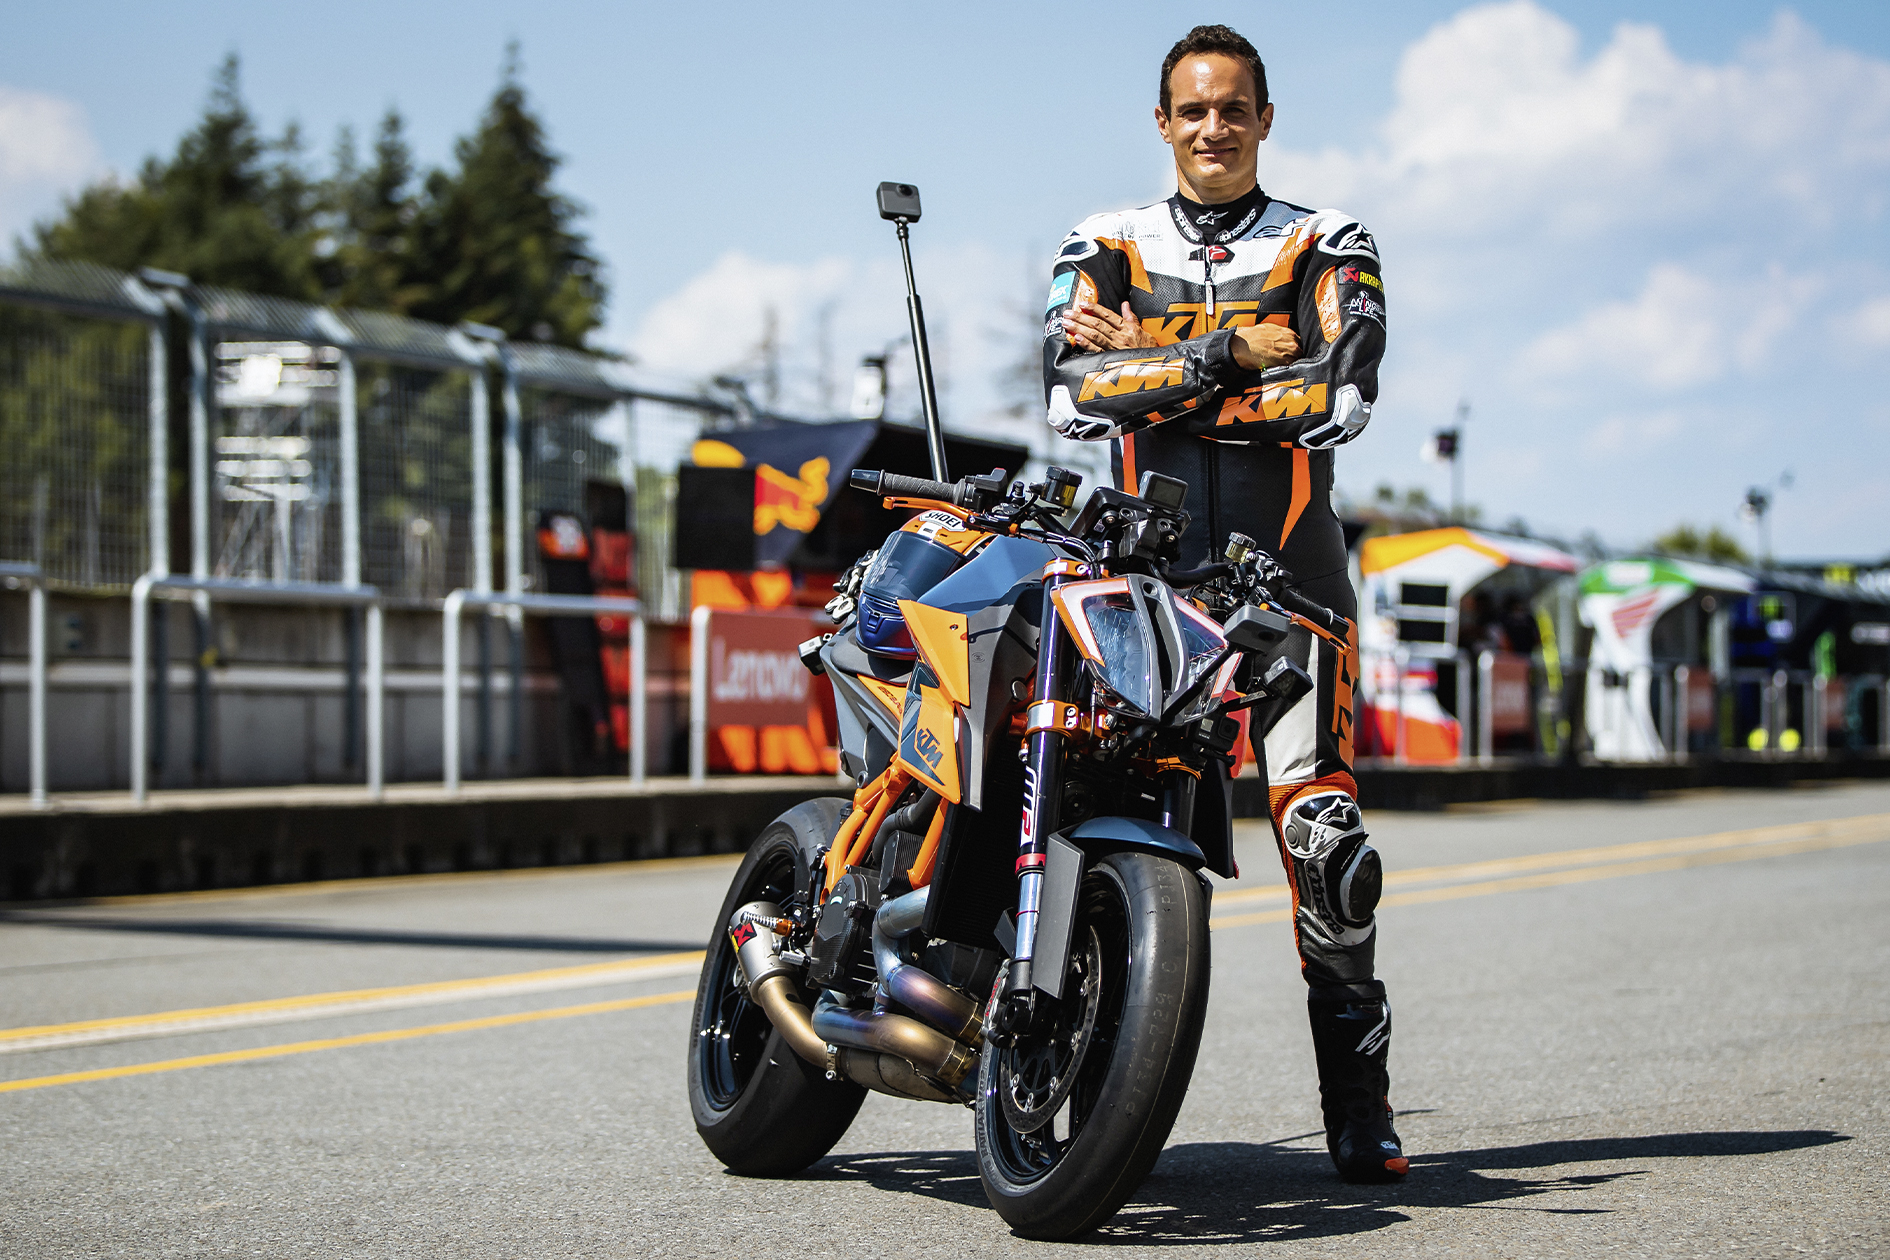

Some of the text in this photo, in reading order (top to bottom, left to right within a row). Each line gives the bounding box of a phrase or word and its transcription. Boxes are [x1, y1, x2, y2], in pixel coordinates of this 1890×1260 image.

[1219, 208, 1257, 243] alpinestars
[1077, 356, 1186, 403] KTM
[1216, 378, 1328, 426] KTM
[925, 511, 961, 528] SHOEI
[916, 727, 944, 769] KTM
[977, 1106, 989, 1158] BATTLAX
